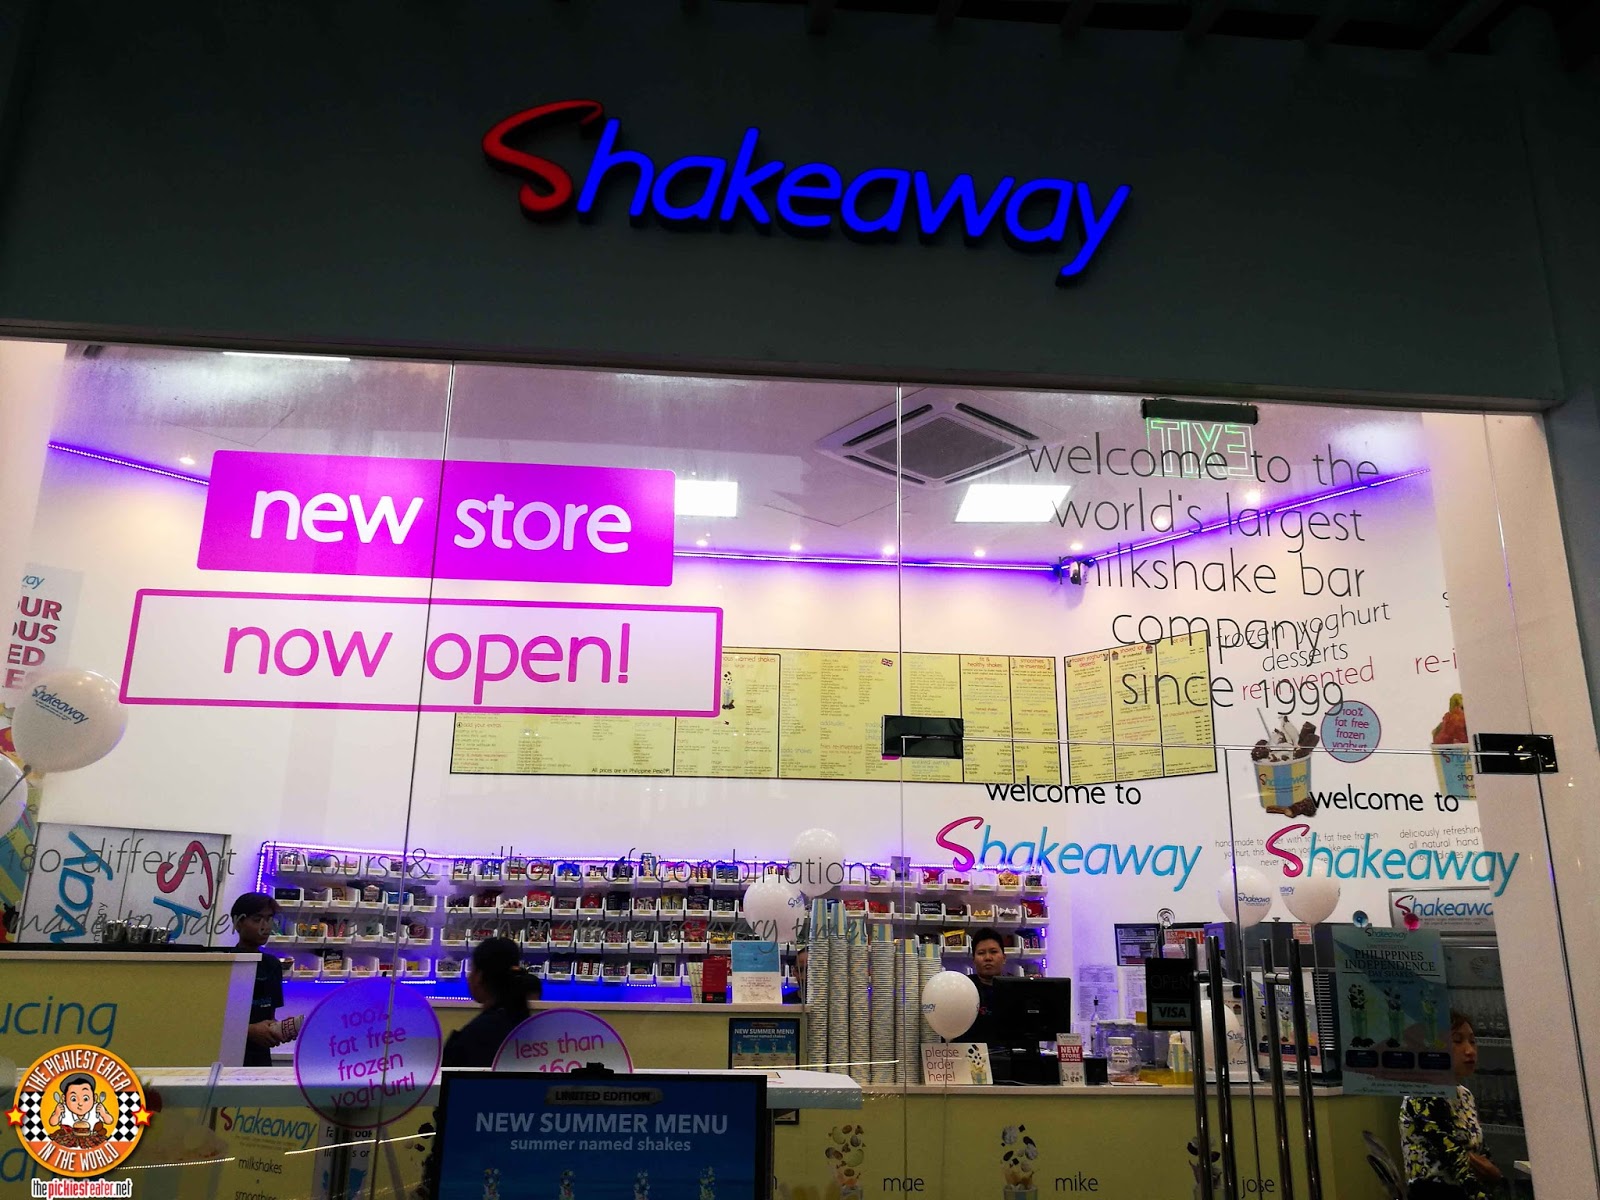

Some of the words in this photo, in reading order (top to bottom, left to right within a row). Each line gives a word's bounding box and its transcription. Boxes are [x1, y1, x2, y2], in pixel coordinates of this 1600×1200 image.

[482, 99, 1131, 278] Shakeaway
[1025, 431, 1228, 481] welcome
[1251, 450, 1292, 483] to
[1312, 444, 1379, 488] the
[249, 487, 424, 545] new
[453, 494, 632, 554] store
[1052, 487, 1202, 533] world's
[1226, 492, 1365, 553] largest
[1058, 541, 1276, 595] milkshake
[1299, 551, 1365, 598] bar
[18, 596, 62, 621] UR
[12, 620, 58, 645] US
[1296, 602, 1391, 646] yoghurt
[1112, 614, 1323, 667] company
[224, 626, 393, 679] now
[425, 621, 631, 706] open!
[1262, 642, 1349, 673] desserts
[32, 684, 89, 725] Shakeaway
[1122, 667, 1234, 709] since
[1258, 678, 1344, 717] 1999
[1335, 716, 1348, 727] fat
[1351, 717, 1370, 729] free
[1342, 707, 1364, 717] 100%
[1336, 728, 1366, 740] frozen
[985, 775, 1105, 804] welcome
[1115, 783, 1142, 805] to
[1309, 783, 1424, 812] welcome
[1434, 791, 1459, 813] to
[1354, 830, 1379, 841] froen
[1400, 827, 1440, 839] deliciously
[1408, 840, 1418, 850] all
[1421, 839, 1451, 849] natural
[1456, 836, 1479, 847] hand
[82, 837, 237, 876] different
[408, 846, 432, 880] &
[654, 848, 882, 887] combinations
[936, 816, 1202, 892] Shakeaway
[1265, 823, 1519, 897] Shakeaway
[167, 903, 248, 936] order
[1344, 959, 1437, 972] INDEPENDENCE
[1354, 948, 1425, 961] PHILIPPINES
[341, 1008, 390, 1029] 100%
[1158, 1006, 1187, 1018] VISA
[328, 1034, 357, 1059] fat
[366, 1025, 407, 1050] free
[513, 1037, 549, 1060] less
[556, 1031, 605, 1056] than
[925, 1046, 960, 1058] please
[1060, 1046, 1080, 1054] NEW
[336, 1052, 404, 1082] frozen
[926, 1060, 955, 1070] order
[927, 1070, 956, 1082] here!
[330, 1072, 416, 1110] yoghurt!
[220, 1106, 318, 1150] Shakeaway
[476, 1112, 535, 1133] NEW
[539, 1113, 648, 1134] SUMMER
[655, 1114, 728, 1134] MENU
[509, 1138, 575, 1151] summer
[579, 1137, 633, 1151] named
[637, 1137, 692, 1152] shakes
[238, 1157, 283, 1175] milkshakes
[882, 1175, 925, 1193] mae
[1054, 1171, 1099, 1193] mike
[1240, 1174, 1275, 1196] jose
